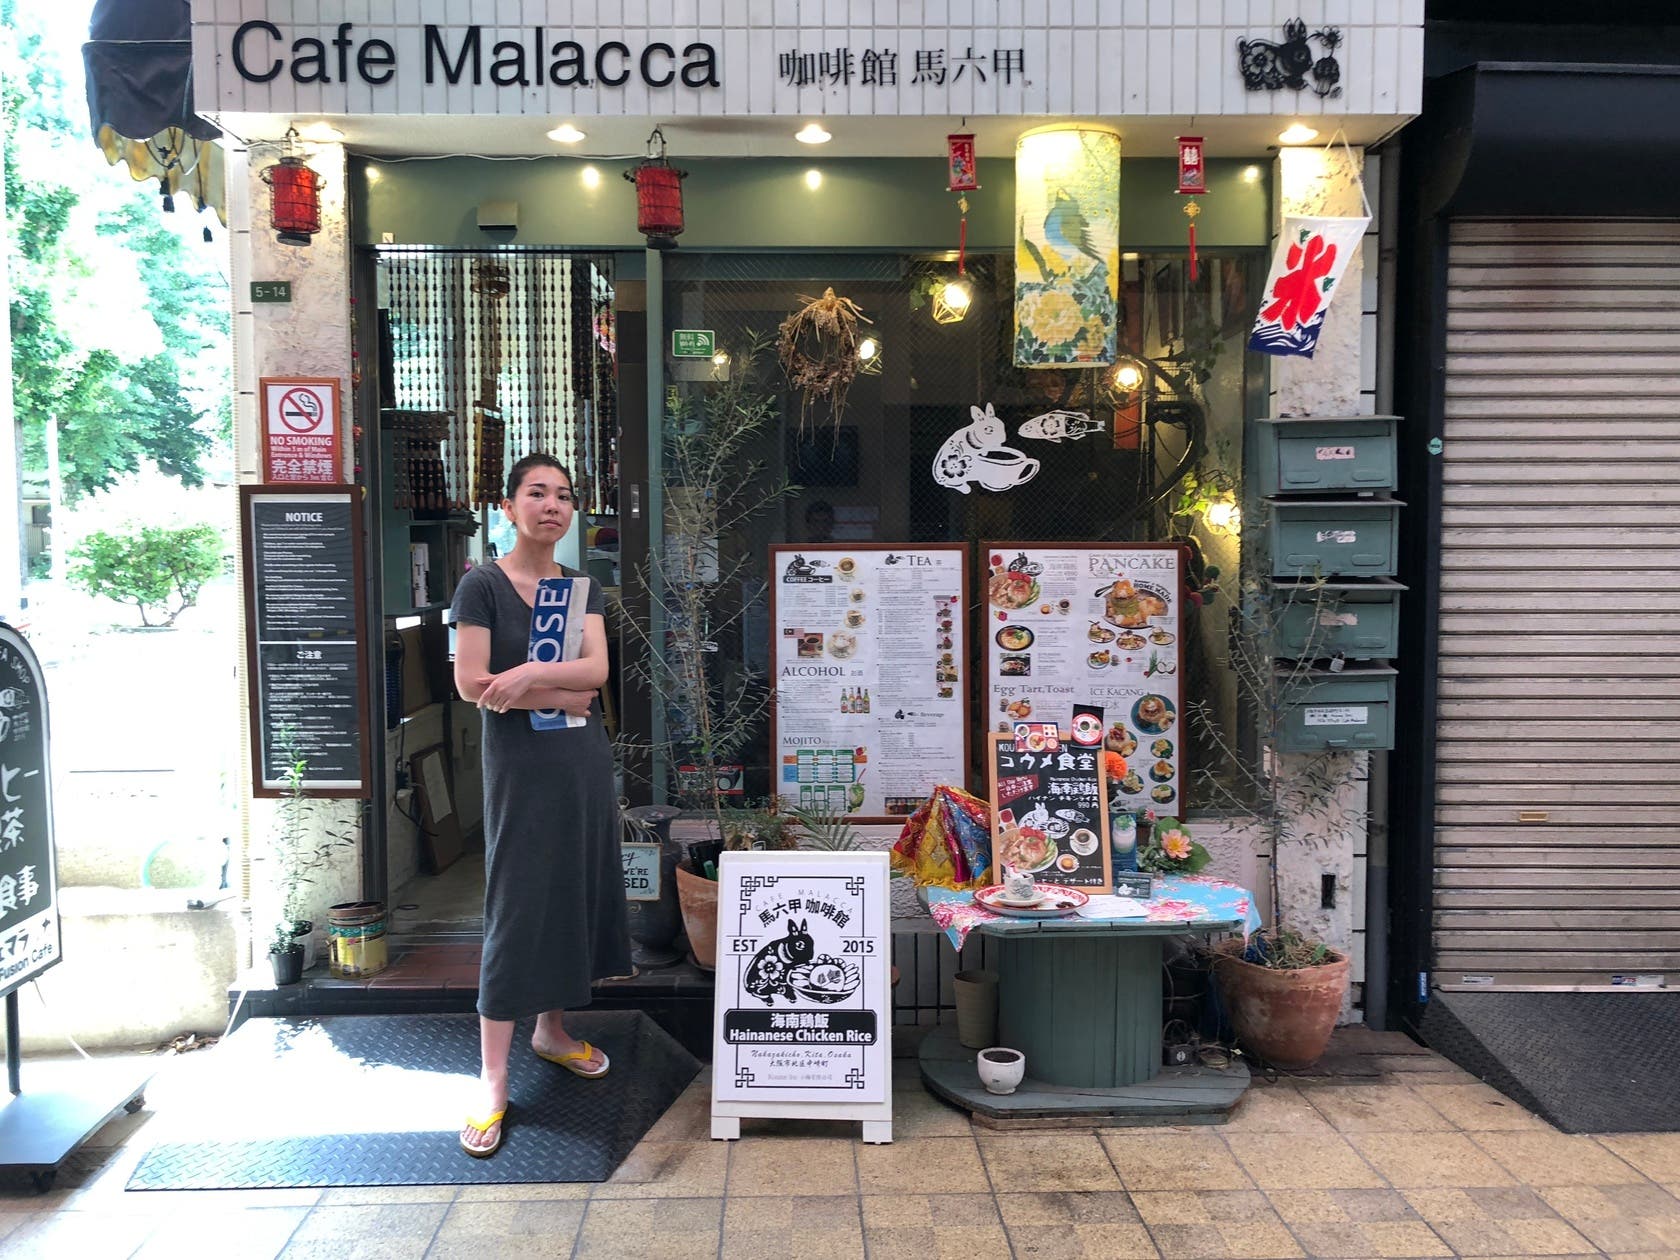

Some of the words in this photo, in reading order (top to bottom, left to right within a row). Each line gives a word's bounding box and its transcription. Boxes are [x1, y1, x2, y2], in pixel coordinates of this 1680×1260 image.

[232, 20, 396, 86] Cafe
[424, 24, 720, 88] Malacca
[779, 47, 898, 87] 咖啡館
[911, 47, 1024, 86] 馬六甲
[255, 286, 286, 297] 5-14
[270, 436, 284, 446] NO
[286, 437, 332, 446] SMOKING
[272, 459, 333, 475] 完全禁煙
[285, 512, 323, 522] NOTICE
[906, 555, 932, 566] TEA
[1089, 557, 1175, 569] PANCAKE
[782, 666, 846, 677] ALCOHOL
[993, 685, 1016, 697] Egg
[783, 736, 822, 745] MOJITO
[1000, 752, 1095, 771] コウメ食堂
[759, 898, 802, 928] 馬六甲
[733, 939, 758, 952] EST
[843, 940, 874, 953] 2015
[730, 1029, 794, 1041] Hainanese
[795, 1029, 844, 1042] Chicken
[846, 1029, 872, 1042] Rice
